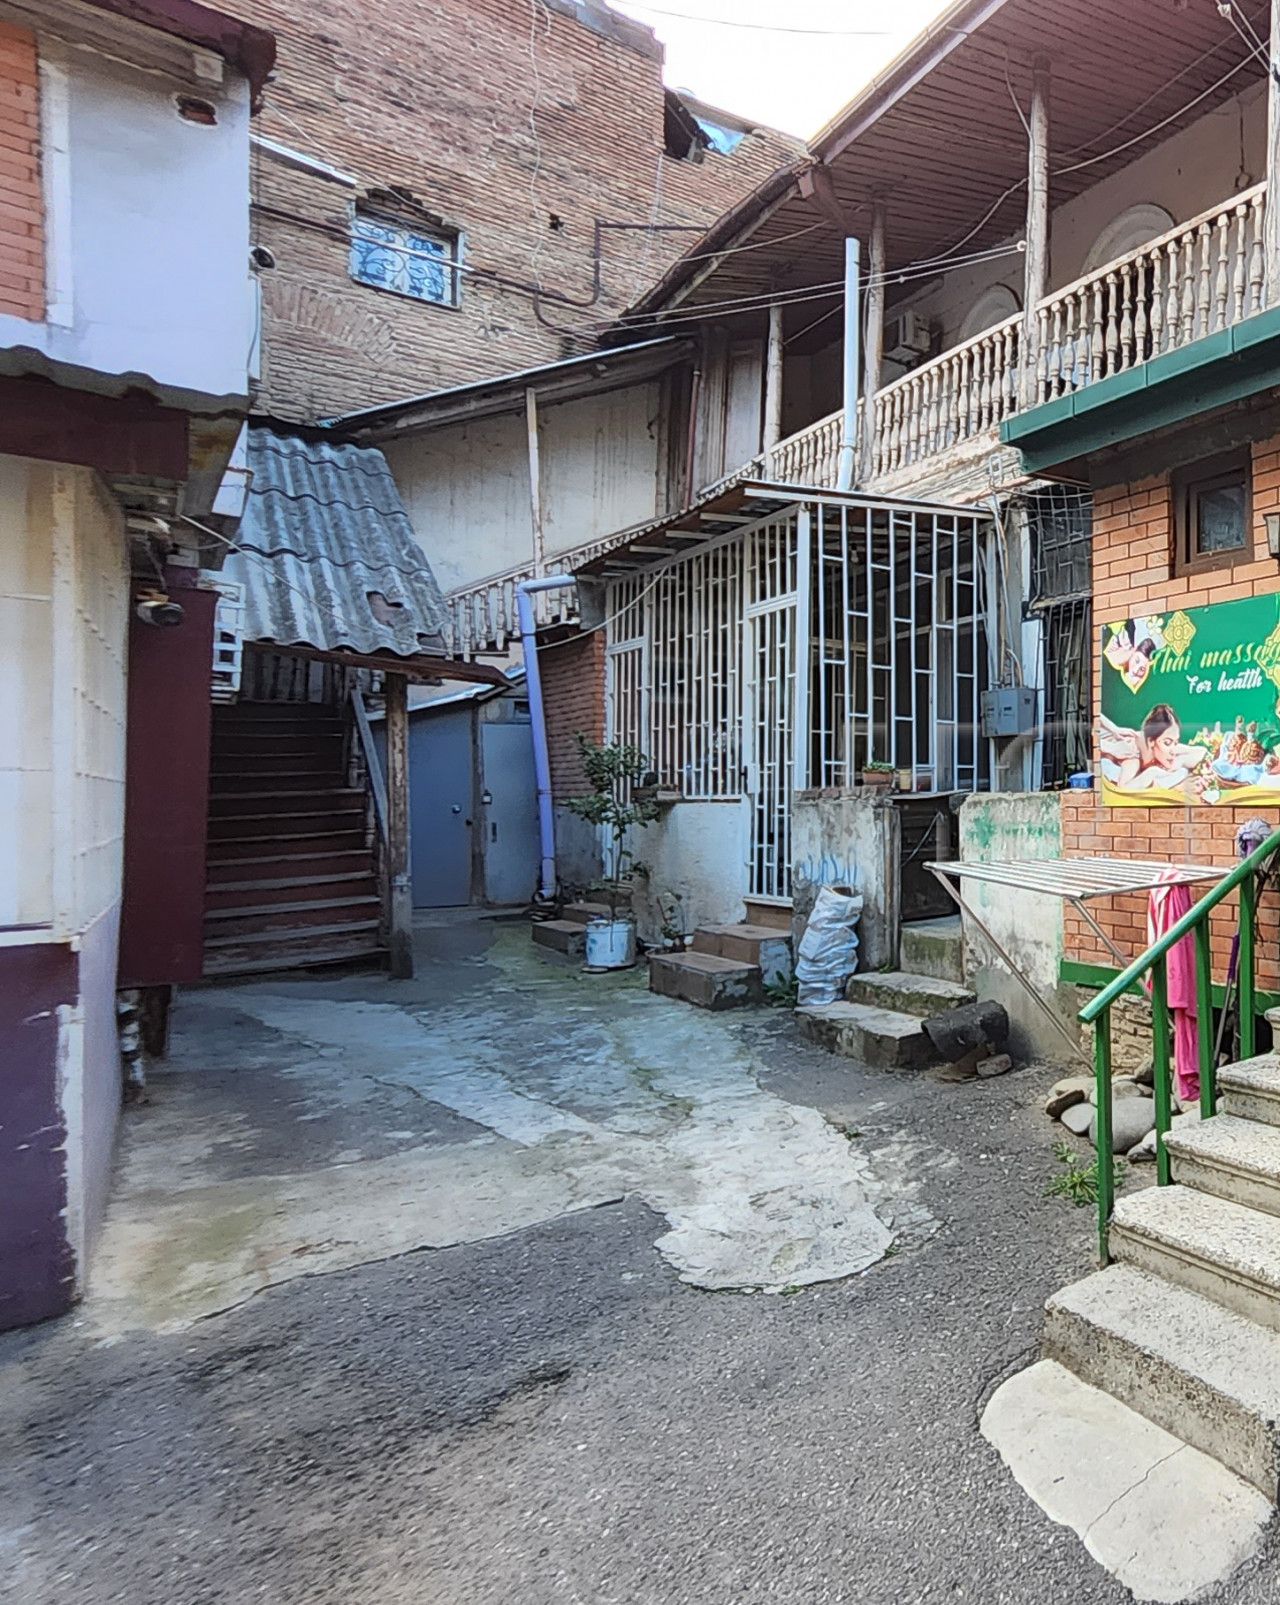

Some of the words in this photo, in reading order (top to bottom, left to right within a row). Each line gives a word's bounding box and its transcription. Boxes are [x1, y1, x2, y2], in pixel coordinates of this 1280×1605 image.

[1151, 646, 1193, 675] Thai
[1186, 675, 1213, 694] For
[1217, 666, 1263, 691] health
